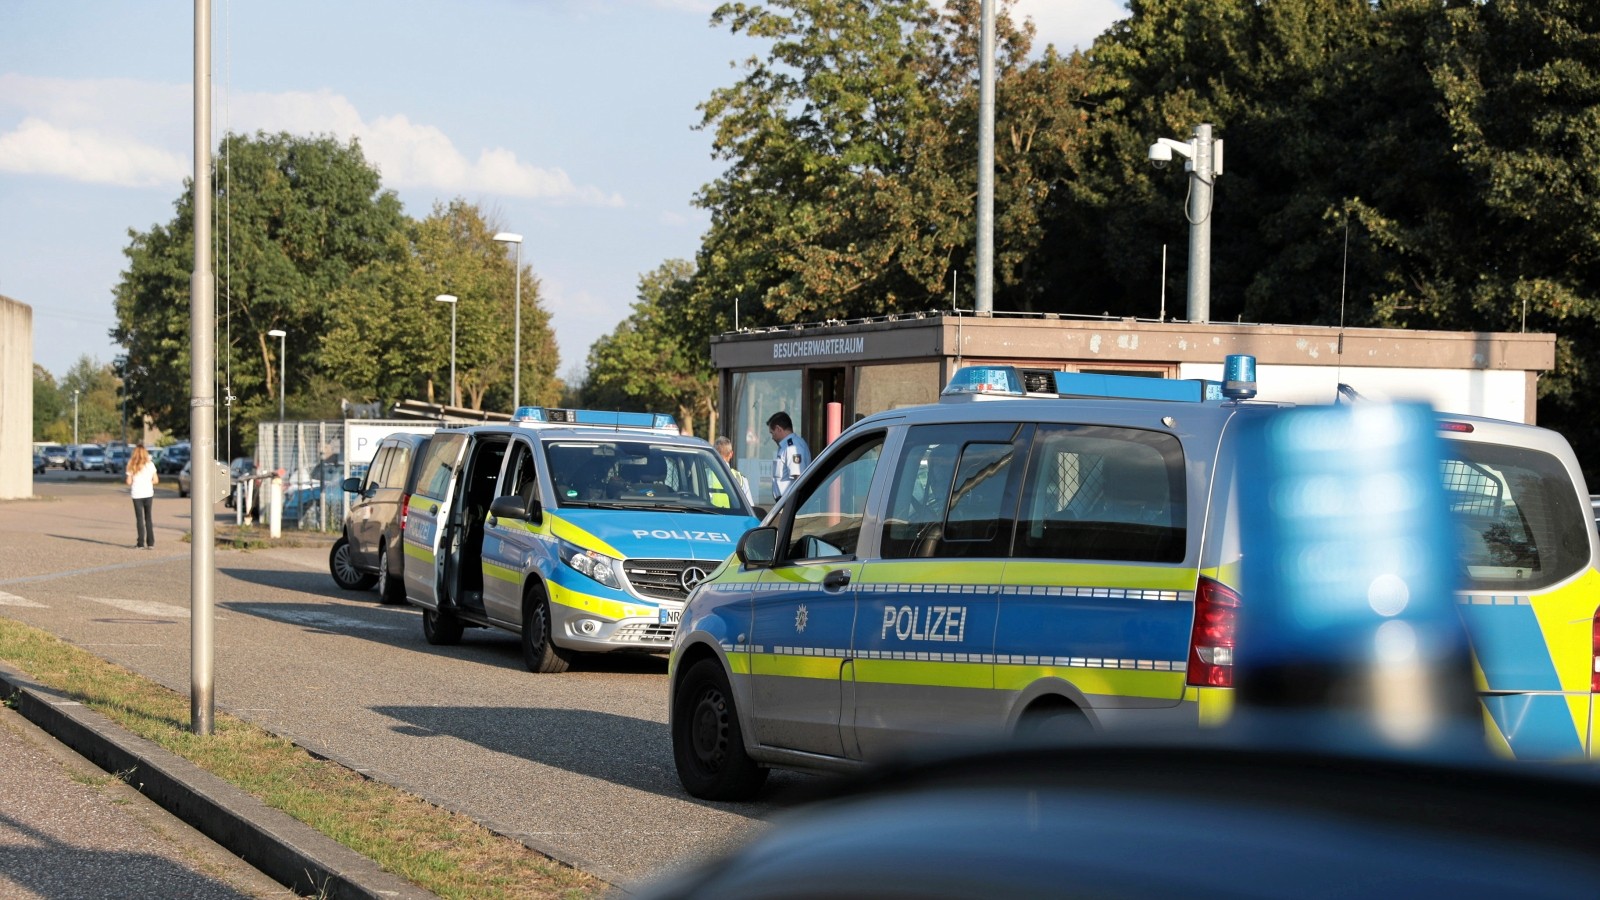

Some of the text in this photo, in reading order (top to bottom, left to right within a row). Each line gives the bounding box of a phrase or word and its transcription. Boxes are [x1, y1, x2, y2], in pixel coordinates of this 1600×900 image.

[773, 337, 864, 358] BESUCHERWARTERAUM
[632, 529, 731, 543] POLIZEI
[881, 605, 967, 642] POLIZEI
